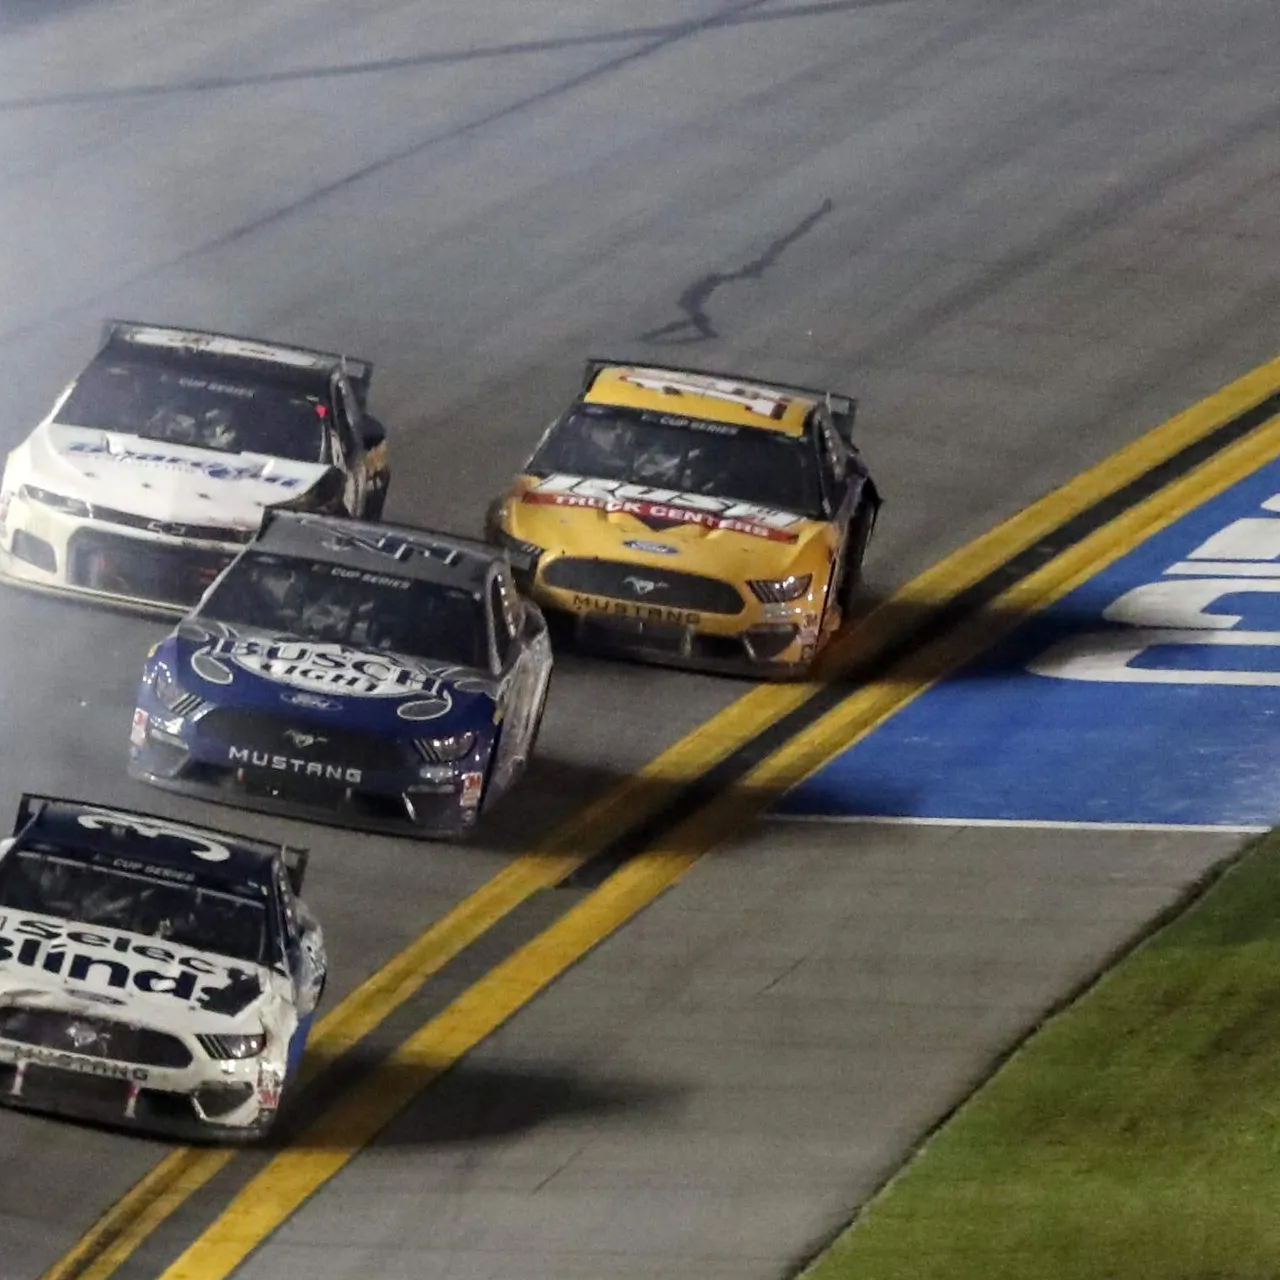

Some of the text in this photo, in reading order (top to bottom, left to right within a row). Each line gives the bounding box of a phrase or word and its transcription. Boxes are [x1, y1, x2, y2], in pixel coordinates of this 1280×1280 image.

[660, 416, 739, 435] CUP SERIES
[556, 496, 641, 514] TRUCK
[330, 567, 361, 579] CUP
[572, 593, 702, 626] MUSTANG
[218, 636, 440, 694] BUSCH
[259, 660, 380, 693] LIGHT
[228, 745, 363, 784] MUSTANG
[112, 857, 143, 873] CUP
